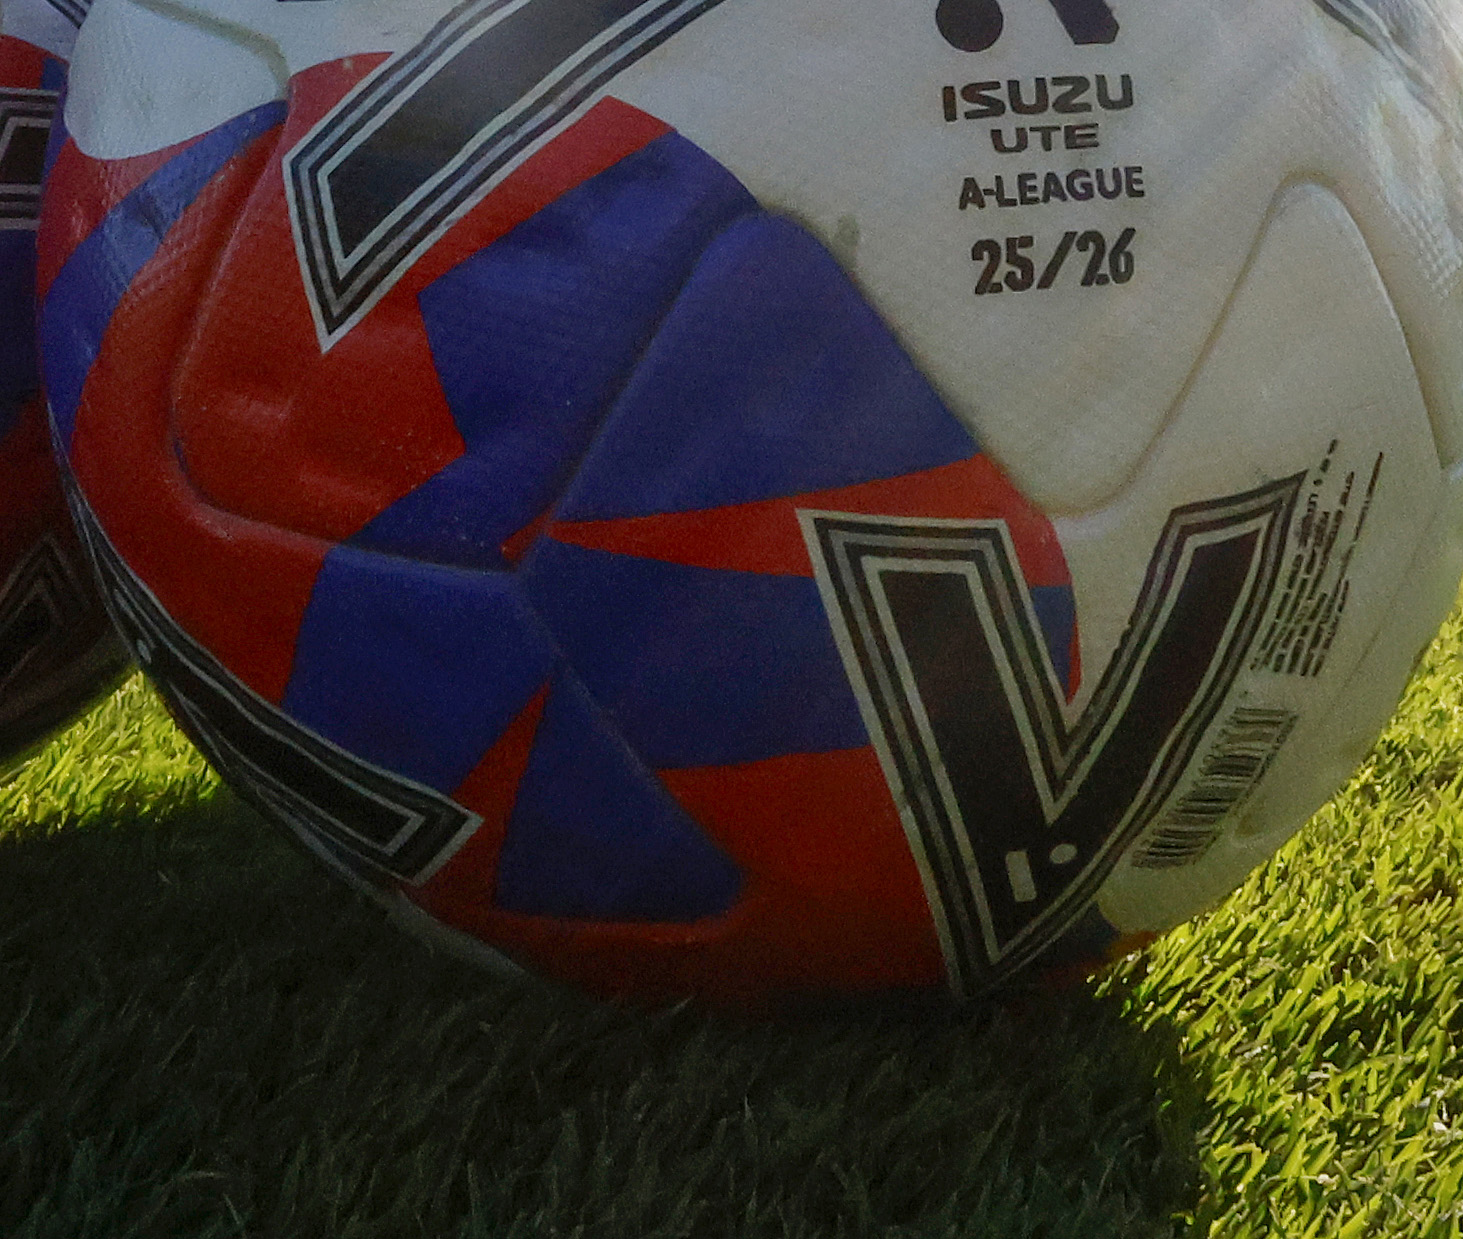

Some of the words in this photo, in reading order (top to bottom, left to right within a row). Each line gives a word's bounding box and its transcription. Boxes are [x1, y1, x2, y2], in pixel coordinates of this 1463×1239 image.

[942, 74, 1134, 122] ISUZU
[990, 123, 1100, 153] UTE
[958, 166, 1145, 210] A-LEAGUE
[971, 228, 1136, 295] 25/26
